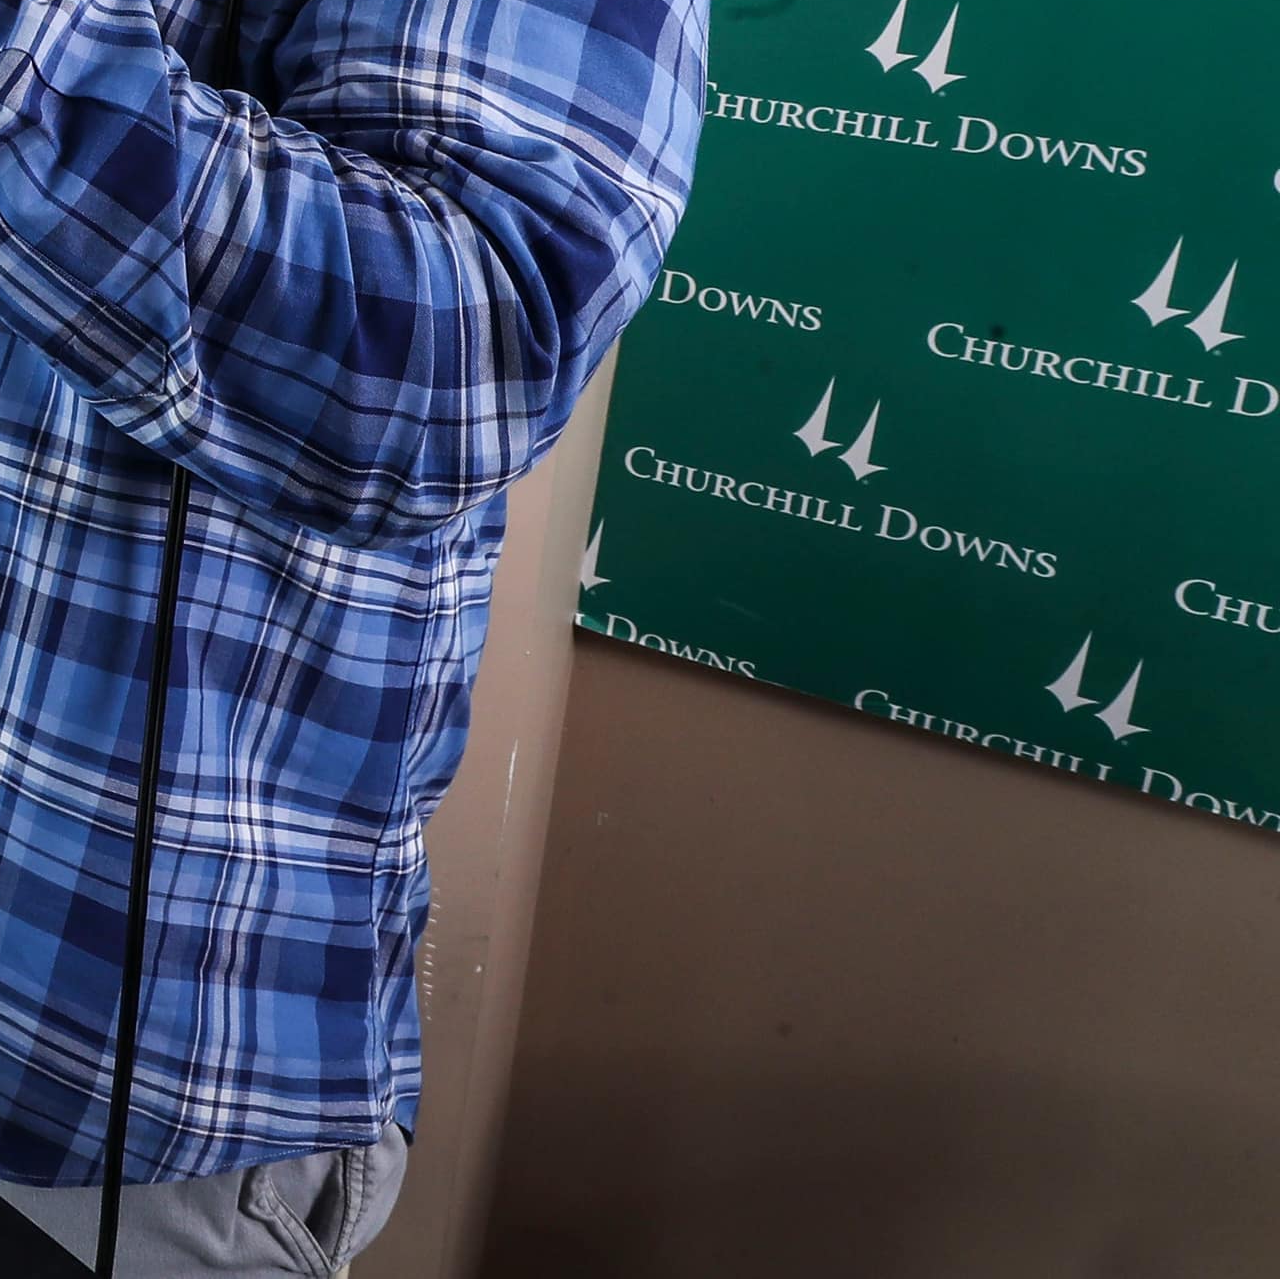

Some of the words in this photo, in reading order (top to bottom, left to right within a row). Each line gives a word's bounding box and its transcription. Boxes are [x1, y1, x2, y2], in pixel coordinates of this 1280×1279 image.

[951, 115, 1148, 177] DOWNS
[657, 268, 822, 332] DOWNS
[927, 322, 1212, 408] CHURCHILL
[624, 446, 862, 532] CHURCHILL
[875, 504, 1057, 578] DOWNS
